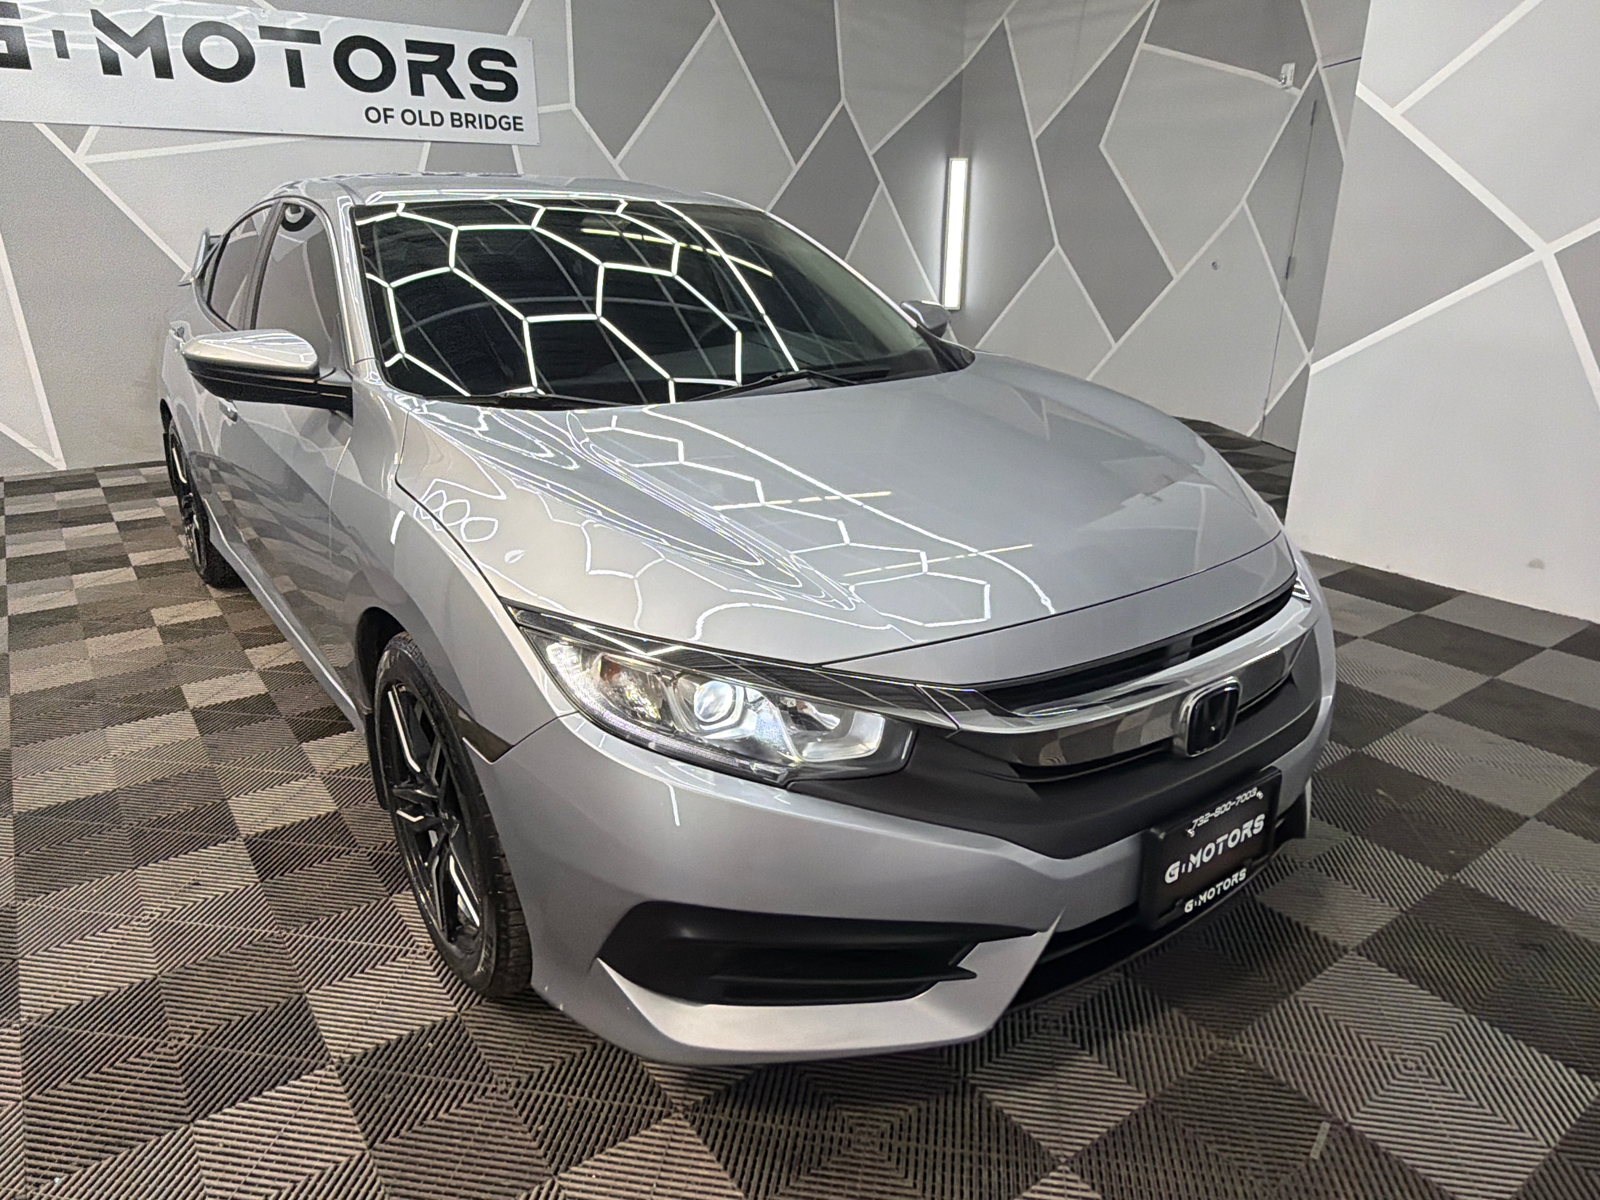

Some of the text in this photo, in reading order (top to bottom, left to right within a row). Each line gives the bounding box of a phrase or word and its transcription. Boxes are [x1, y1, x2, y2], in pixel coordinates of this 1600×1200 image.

[365, 106, 524, 132] OF OLD BRIDGE
